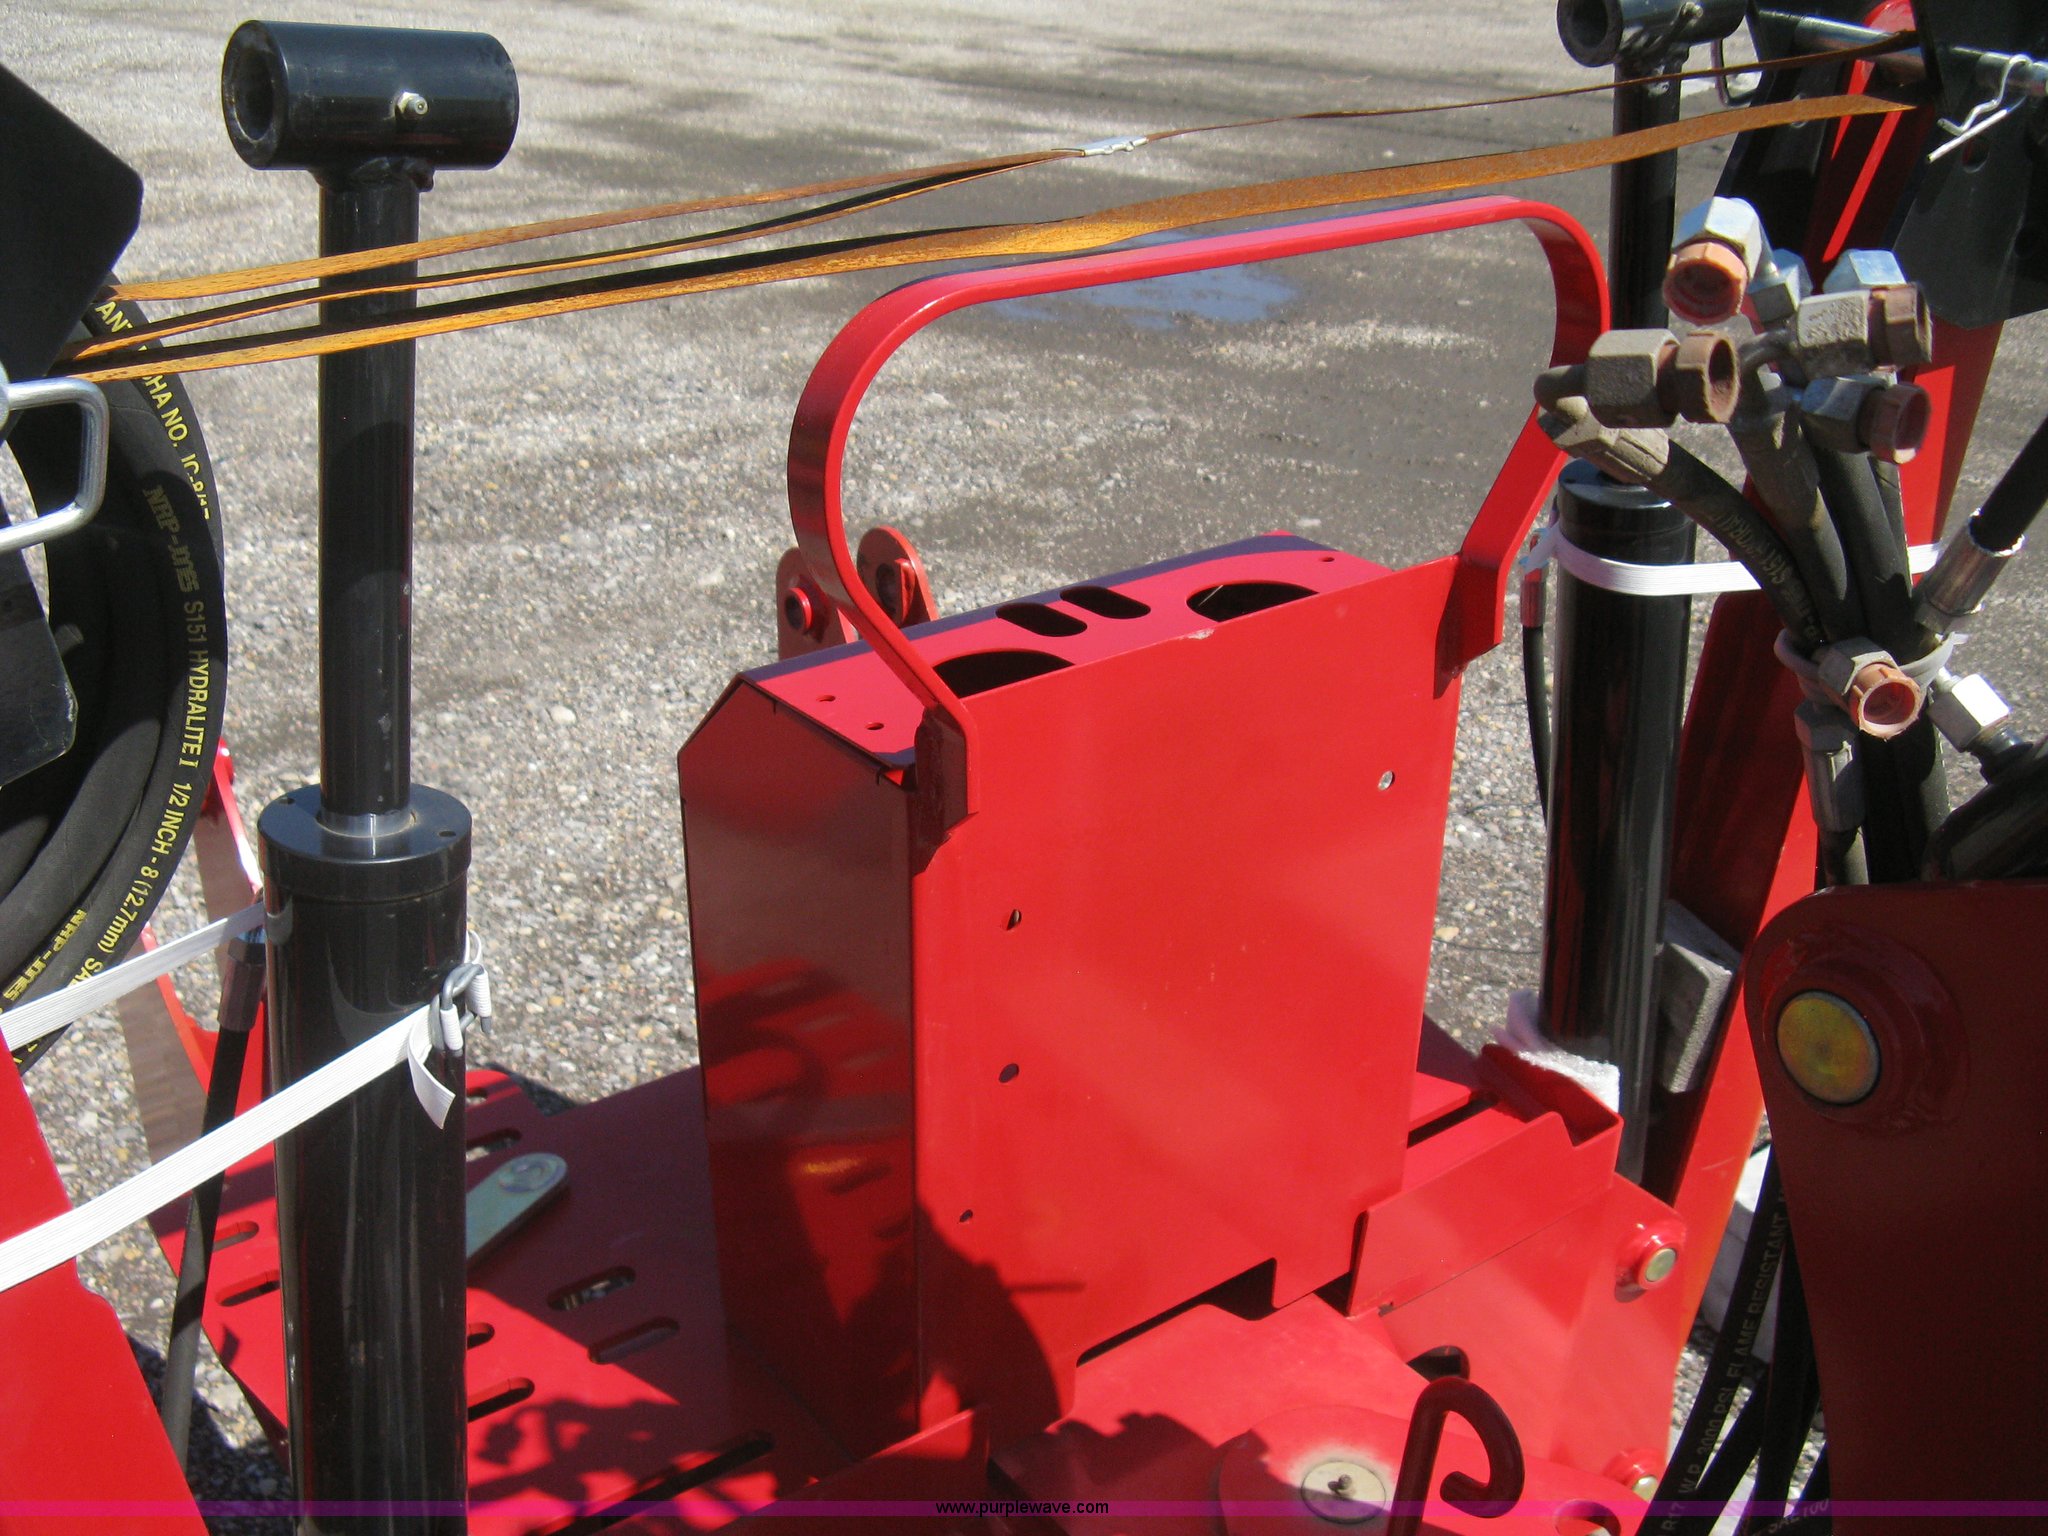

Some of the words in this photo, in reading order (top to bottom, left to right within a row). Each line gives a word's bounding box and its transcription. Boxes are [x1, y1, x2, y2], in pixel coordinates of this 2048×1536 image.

[161, 407, 189, 448] NO.
[184, 601, 207, 643] S151
[180, 649, 208, 757] HYDRALITE
[169, 781, 192, 807] 1/2
[155, 810, 185, 855] INCH
[140, 866, 159, 879] 8
[97, 879, 153, 954] (12.7mm)
[66, 956, 103, 989] SA
[1727, 1315, 1760, 1379] FLAME
[1746, 1213, 1789, 1317] RESISTANT
